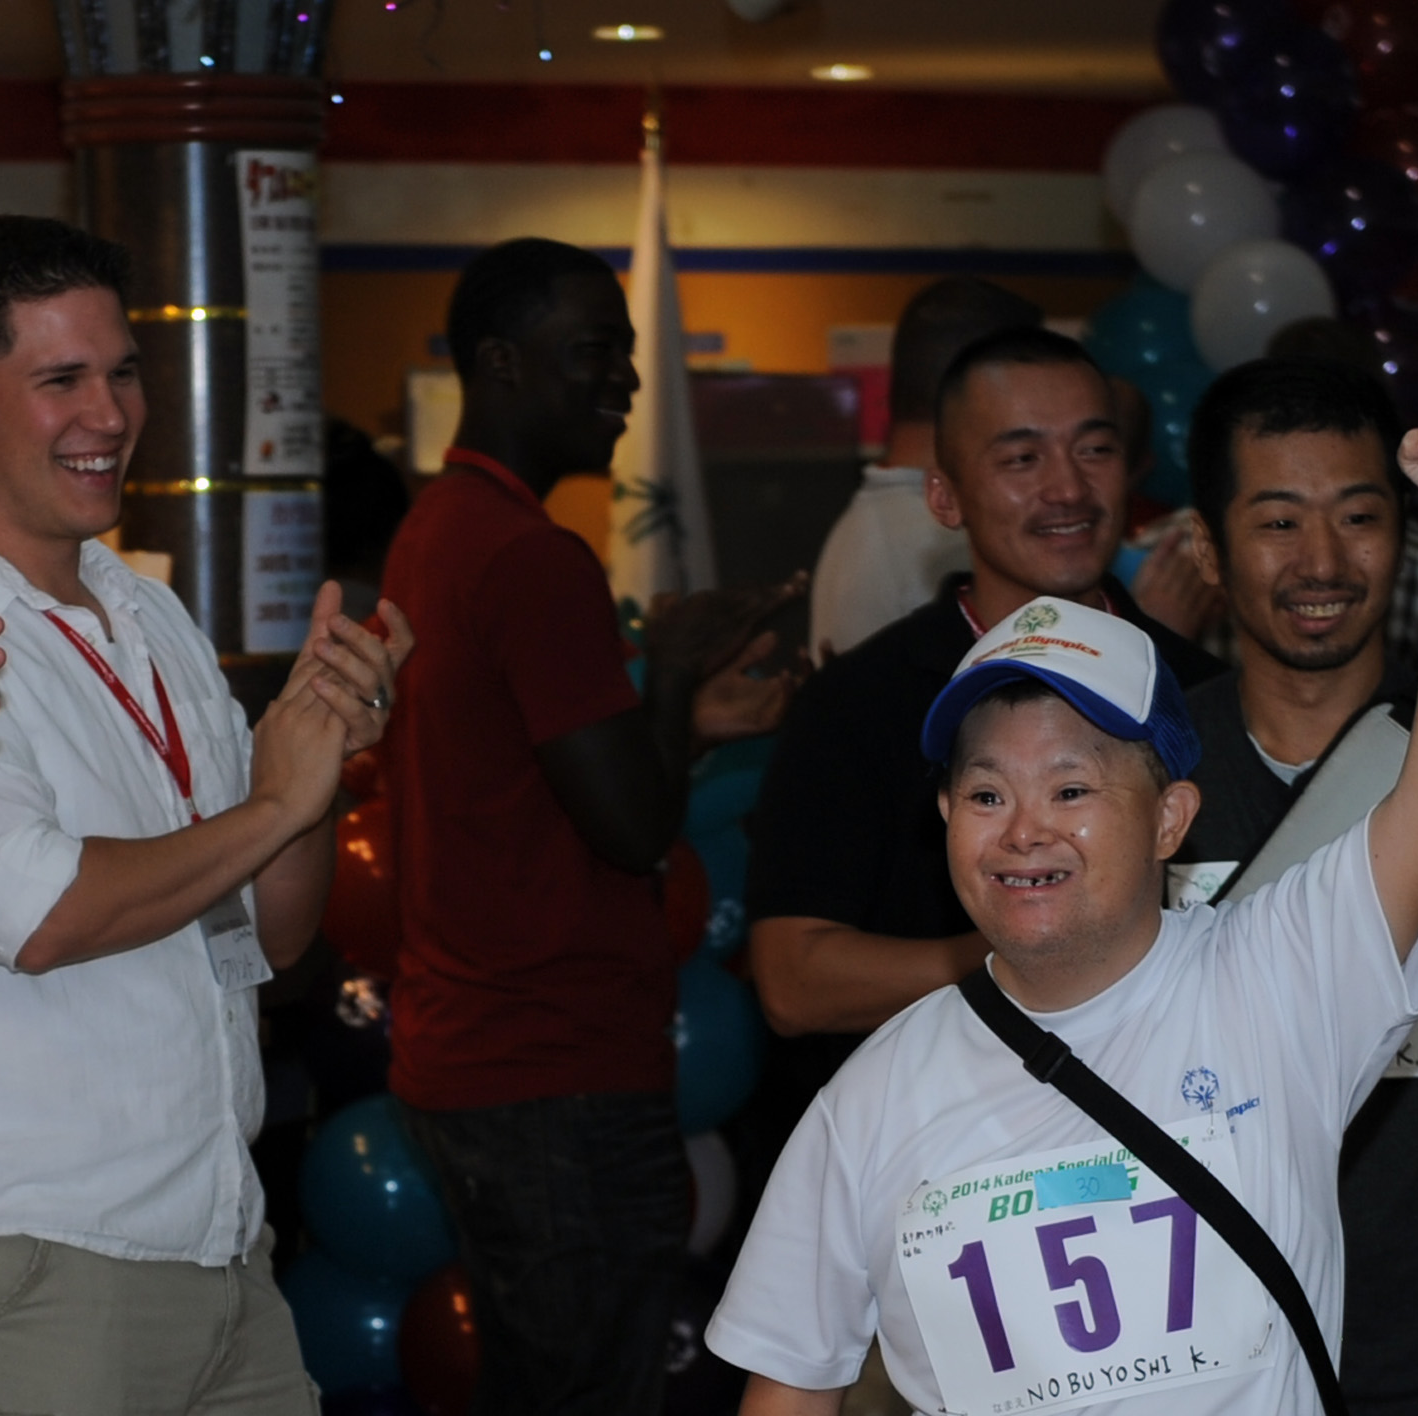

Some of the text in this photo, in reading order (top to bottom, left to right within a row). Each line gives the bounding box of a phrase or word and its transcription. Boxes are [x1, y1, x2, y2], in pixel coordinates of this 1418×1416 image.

[1023, 635, 1103, 658] Olympics
[950, 1177, 991, 1201] 2014
[1075, 1176, 1101, 1199] 30
[947, 1195, 1198, 1374] 157
[1027, 1345, 1220, 1406] NOBUYOSHI K.
